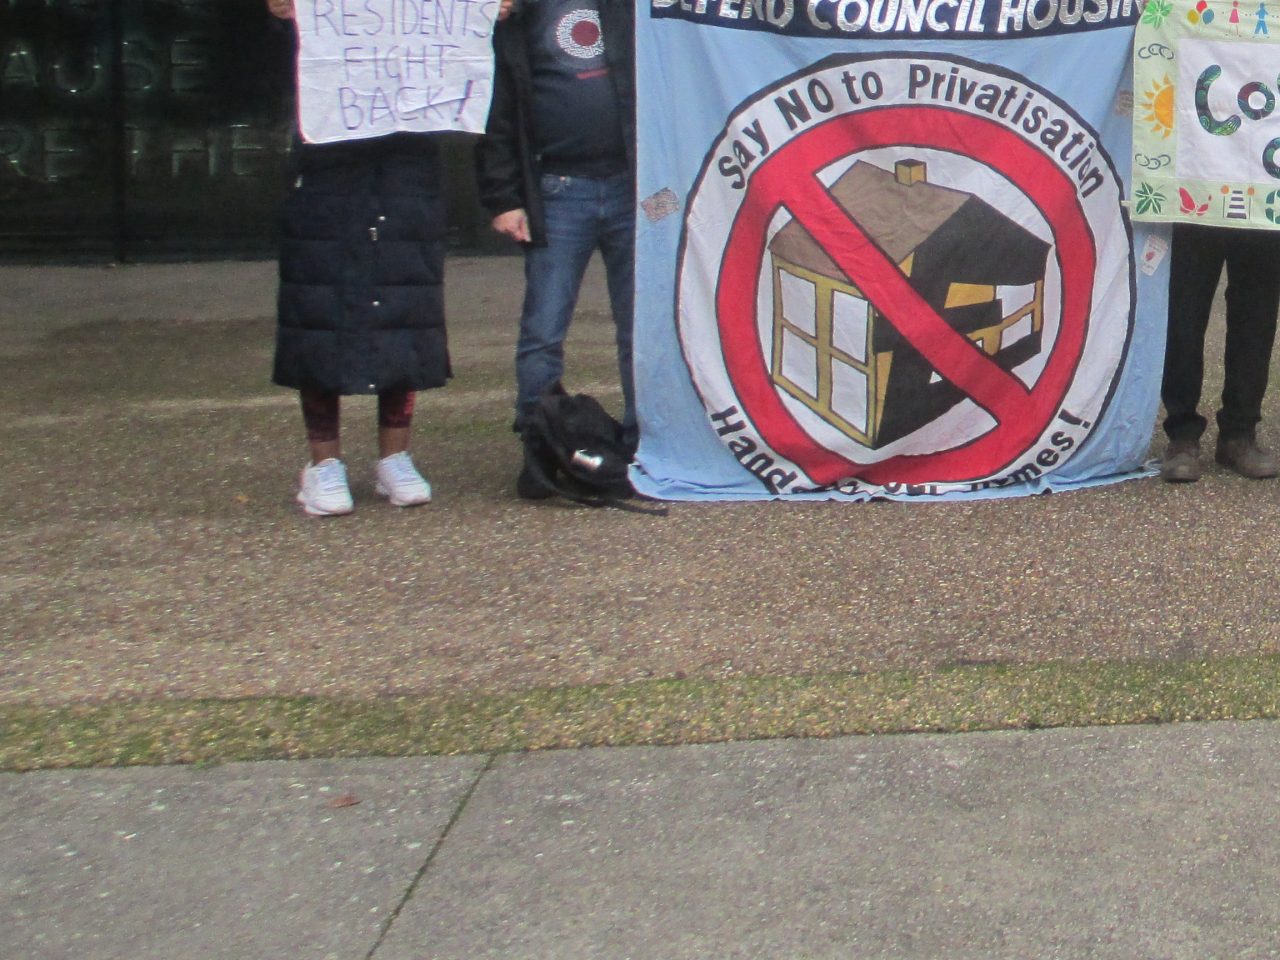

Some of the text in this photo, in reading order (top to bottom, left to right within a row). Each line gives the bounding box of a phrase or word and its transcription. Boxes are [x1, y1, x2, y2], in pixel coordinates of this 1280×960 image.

[343, 43, 461, 84] FIGHT
[338, 79, 474, 131] BACK!
[717, 63, 1105, 199] Say NO to Privatisation
